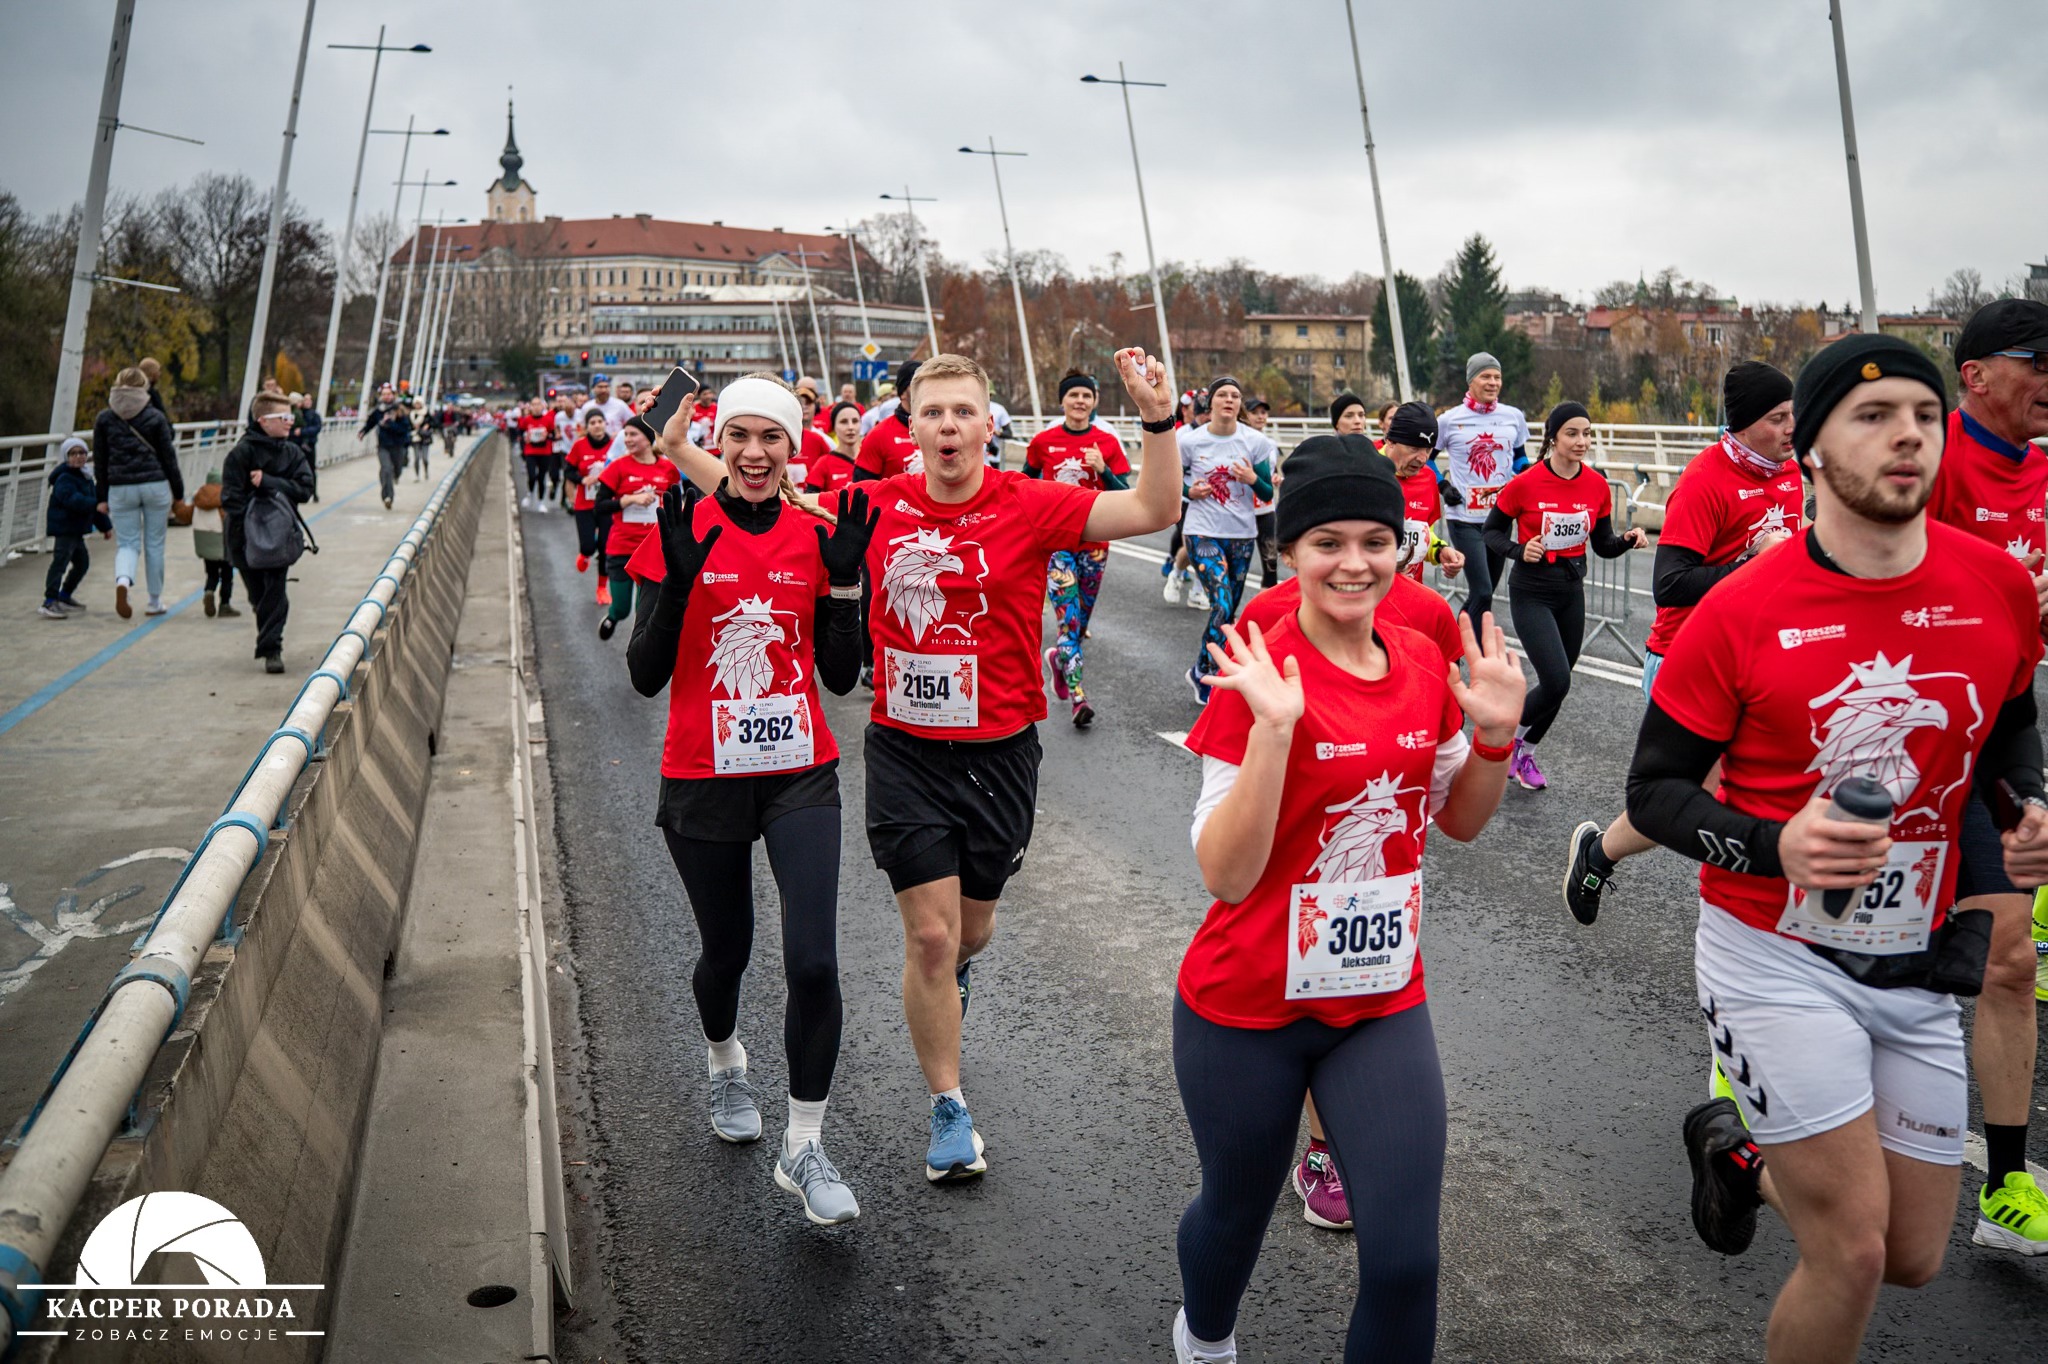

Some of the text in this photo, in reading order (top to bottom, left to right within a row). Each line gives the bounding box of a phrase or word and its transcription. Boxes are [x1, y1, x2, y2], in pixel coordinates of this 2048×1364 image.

[1554, 523, 1581, 537] 3362
[1801, 623, 1846, 639] rzeszów
[903, 672, 950, 700] 2154
[910, 699, 942, 710] Bartłomiej
[738, 716, 794, 743] 3262
[759, 744, 776, 752] Ilona
[1334, 742, 1367, 752] rzeszów
[1857, 870, 1904, 909] 52
[1853, 911, 1874, 925] Filip
[1328, 909, 1403, 956] 3035
[1341, 954, 1391, 969] Aleksandra
